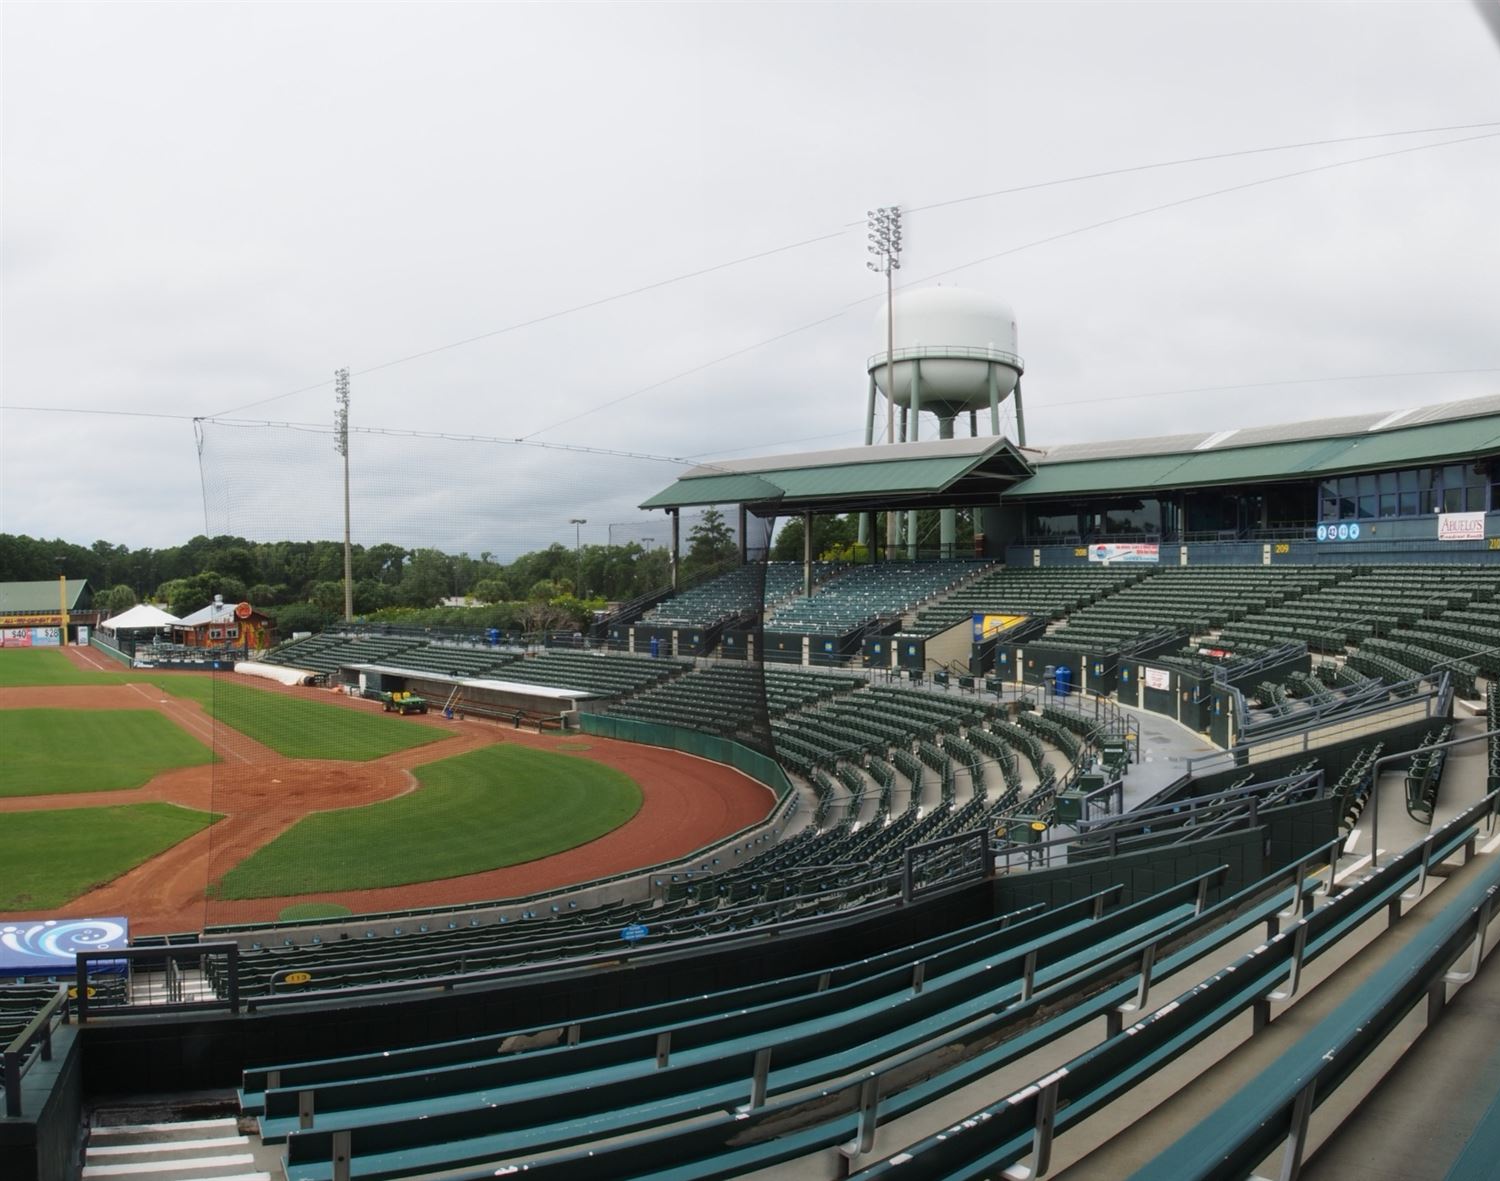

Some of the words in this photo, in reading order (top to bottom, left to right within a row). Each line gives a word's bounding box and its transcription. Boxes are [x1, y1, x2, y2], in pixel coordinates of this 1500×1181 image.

[1275, 544, 1290, 553] 209
[12, 629, 26, 638] $40
[45, 629, 58, 637] $28
